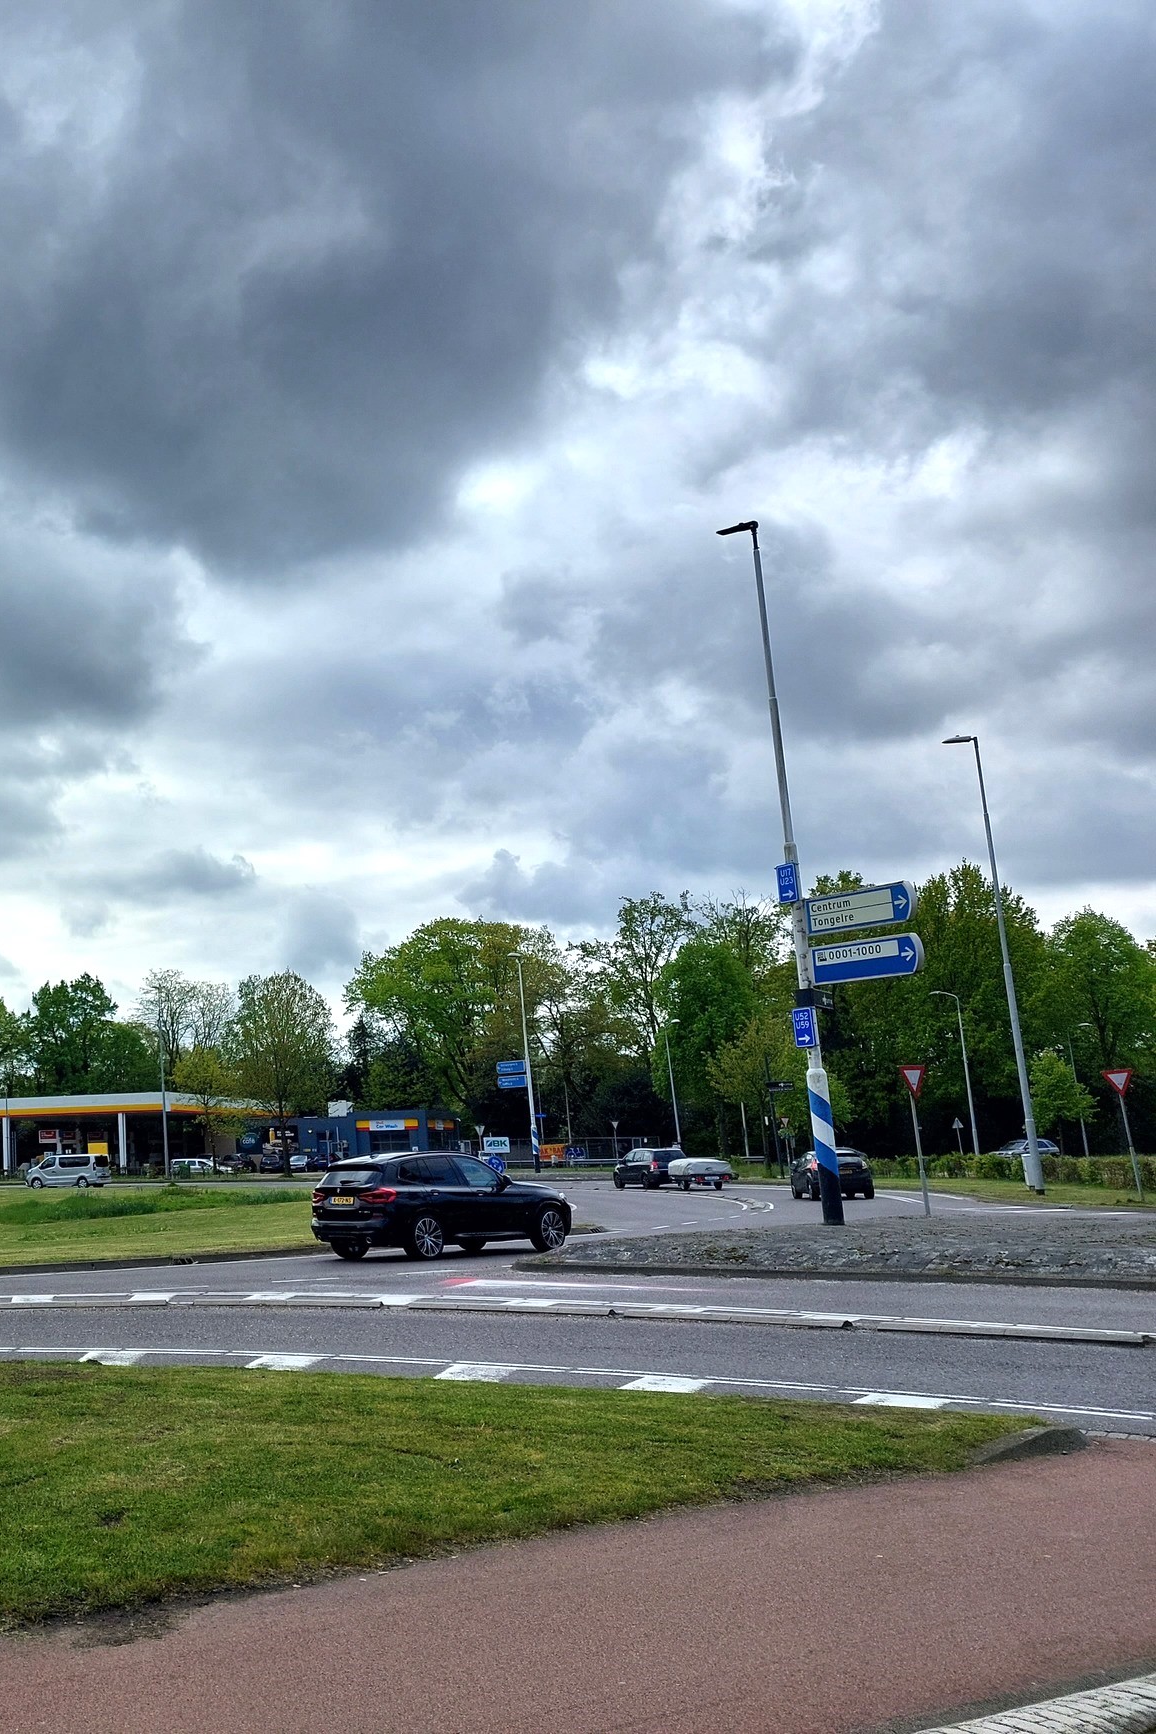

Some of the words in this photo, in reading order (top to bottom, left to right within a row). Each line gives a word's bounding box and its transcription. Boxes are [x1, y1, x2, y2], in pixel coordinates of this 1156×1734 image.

[780, 868, 791, 877] U17
[780, 877, 793, 886] U23
[810, 900, 850, 912] Centrum
[812, 914, 854, 926] Tongelre
[828, 944, 881, 960] 0001-1000
[795, 1012, 808, 1020] U52
[796, 1020, 810, 1029] U59
